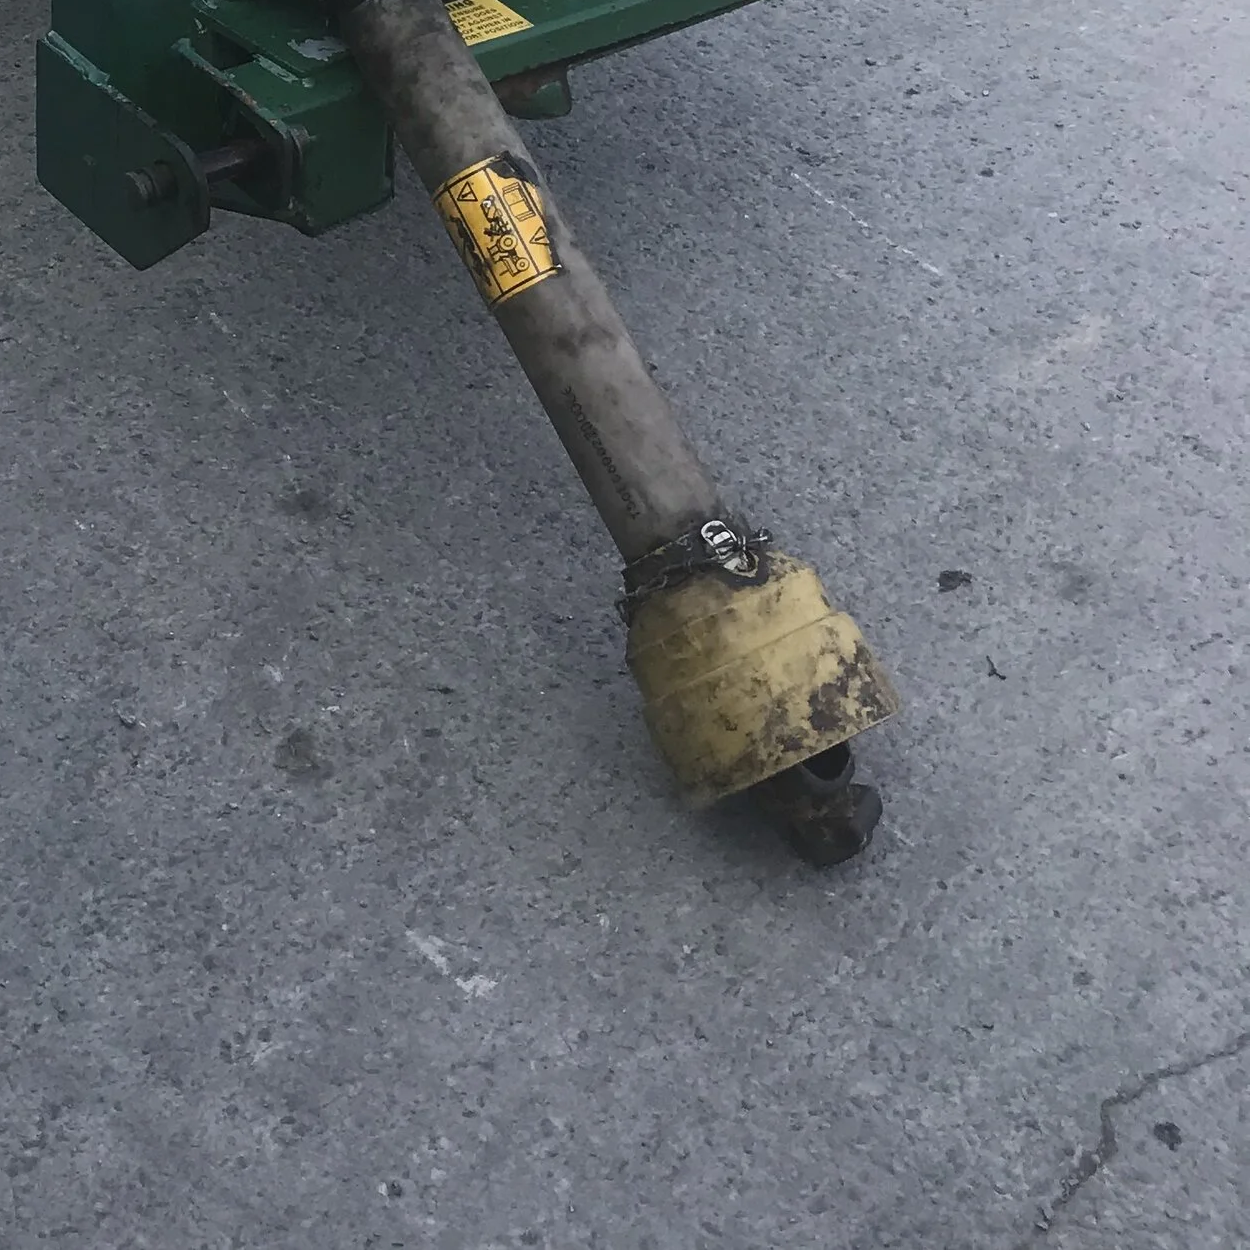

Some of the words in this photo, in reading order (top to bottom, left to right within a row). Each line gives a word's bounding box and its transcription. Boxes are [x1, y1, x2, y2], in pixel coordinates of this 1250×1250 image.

[451, 5, 486, 18] ENSURE
[473, 8, 498, 18] DOES
[468, 12, 503, 26] AGAINST
[477, 20, 501, 31] WHEN
[465, 32, 483, 41] ORT
